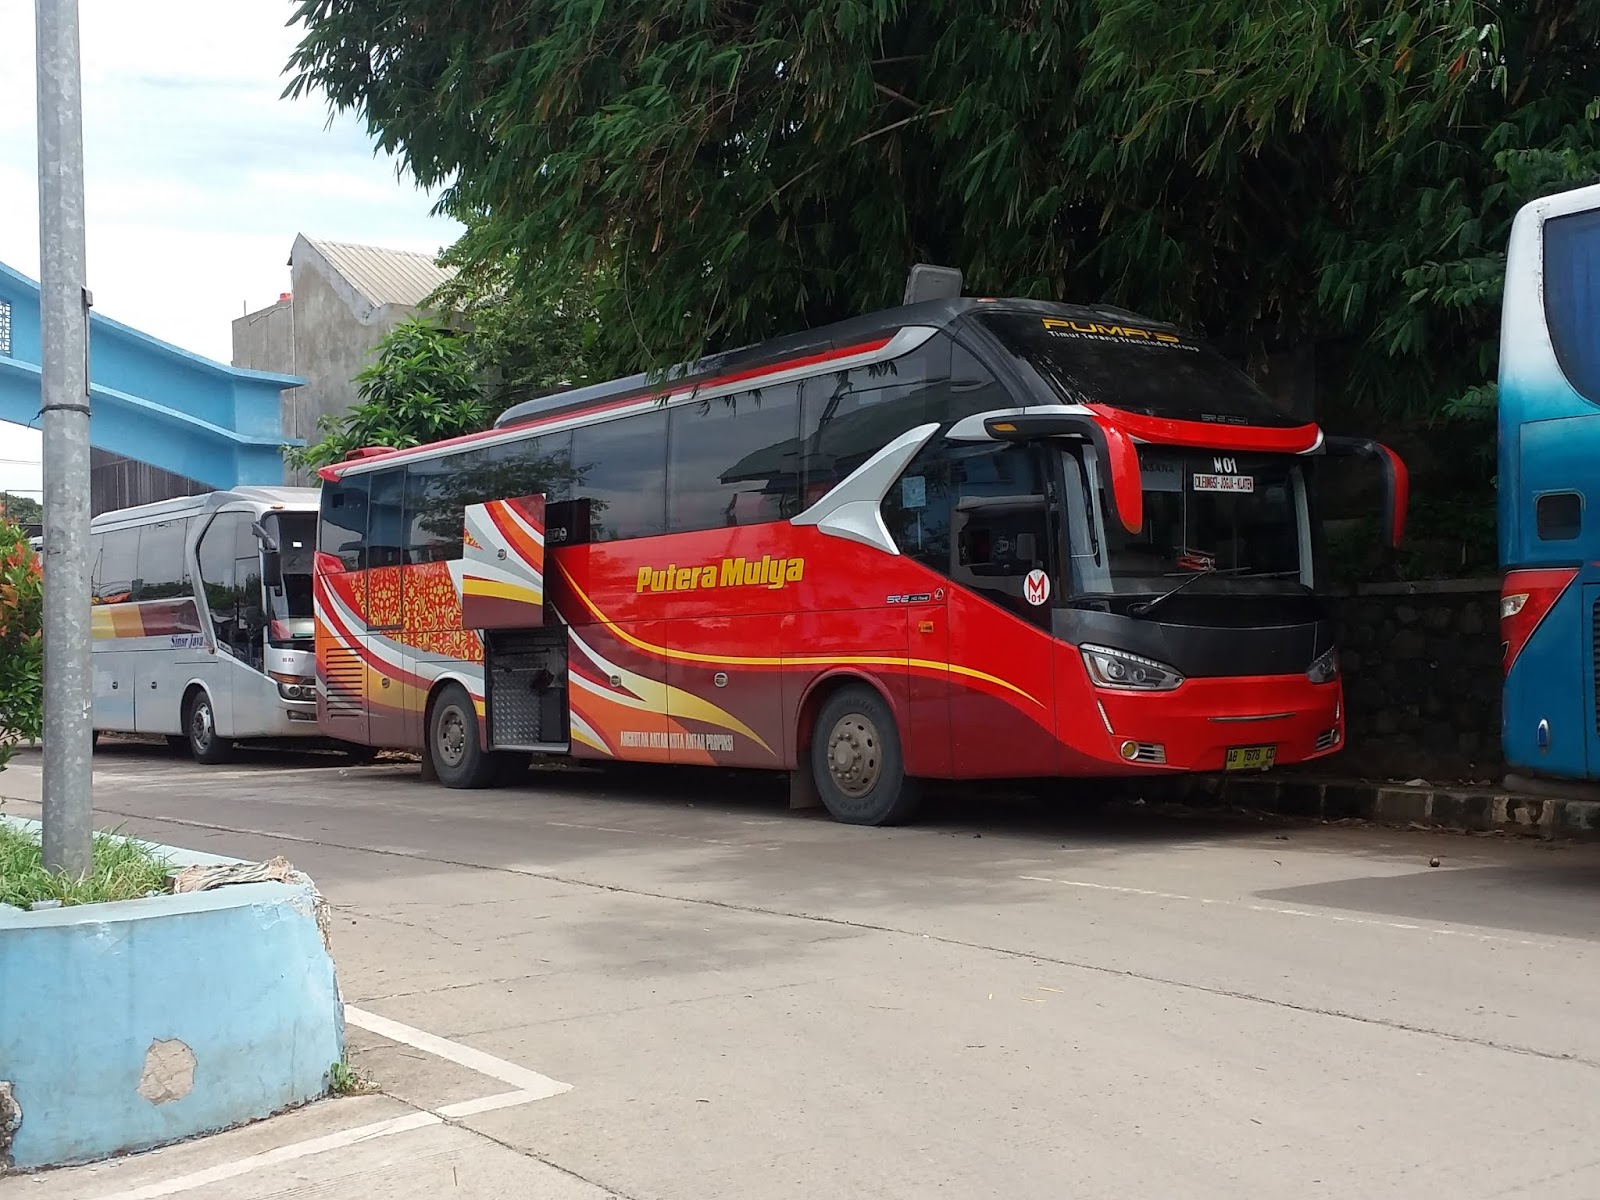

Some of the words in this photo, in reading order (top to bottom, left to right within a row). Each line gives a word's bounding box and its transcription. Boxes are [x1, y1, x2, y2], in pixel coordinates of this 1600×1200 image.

[1047, 330, 1080, 339] Timur
[1118, 336, 1169, 347] Transindo
[1169, 342, 1200, 353] Group
[1142, 463, 1175, 473] KSANA
[636, 563, 718, 593] Putera
[719, 554, 805, 590] Mulya
[1028, 574, 1045, 600] M
